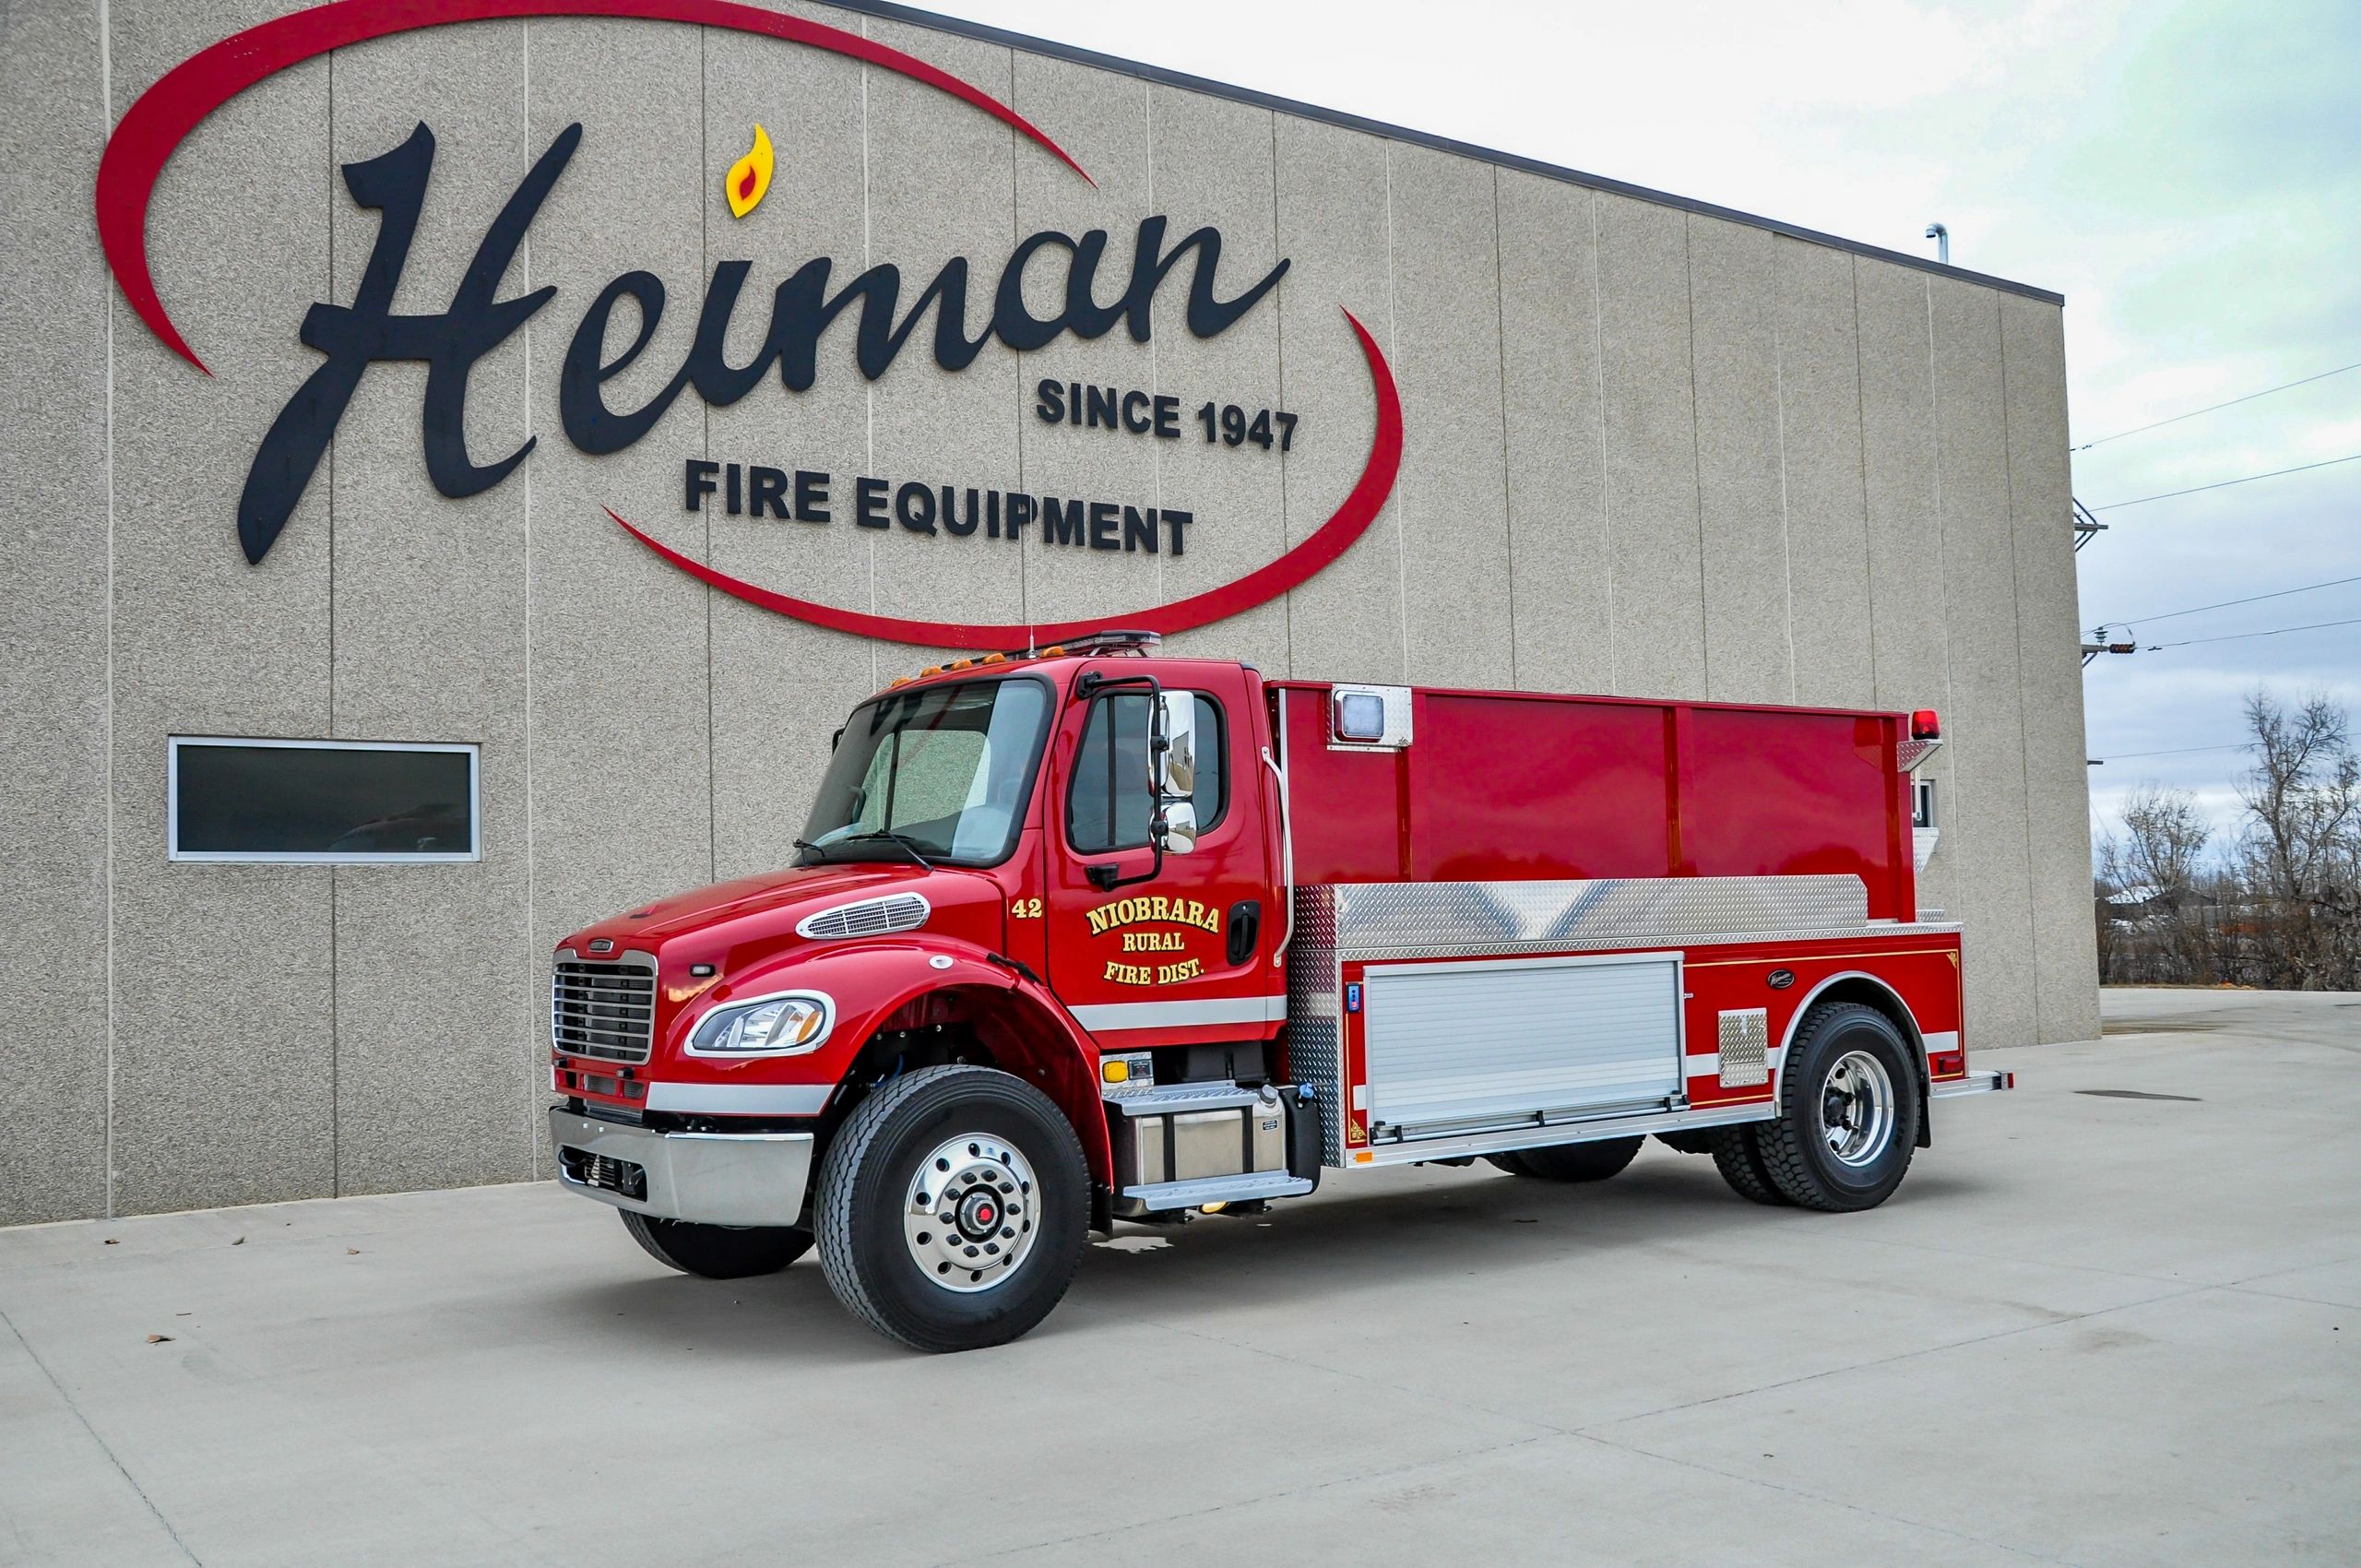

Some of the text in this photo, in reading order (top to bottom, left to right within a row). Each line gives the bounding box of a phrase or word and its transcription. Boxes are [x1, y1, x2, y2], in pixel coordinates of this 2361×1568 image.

[237, 120, 1291, 564] Heiman
[1037, 378, 1299, 453] SINCE 1947
[685, 458, 1193, 557] FIRE EQUIPMENT
[1011, 897, 1043, 920] 42
[1086, 896, 1220, 935] NIOBRARA
[1121, 932, 1185, 953] RURAL
[1103, 957, 1204, 985] FIRE DIST.
